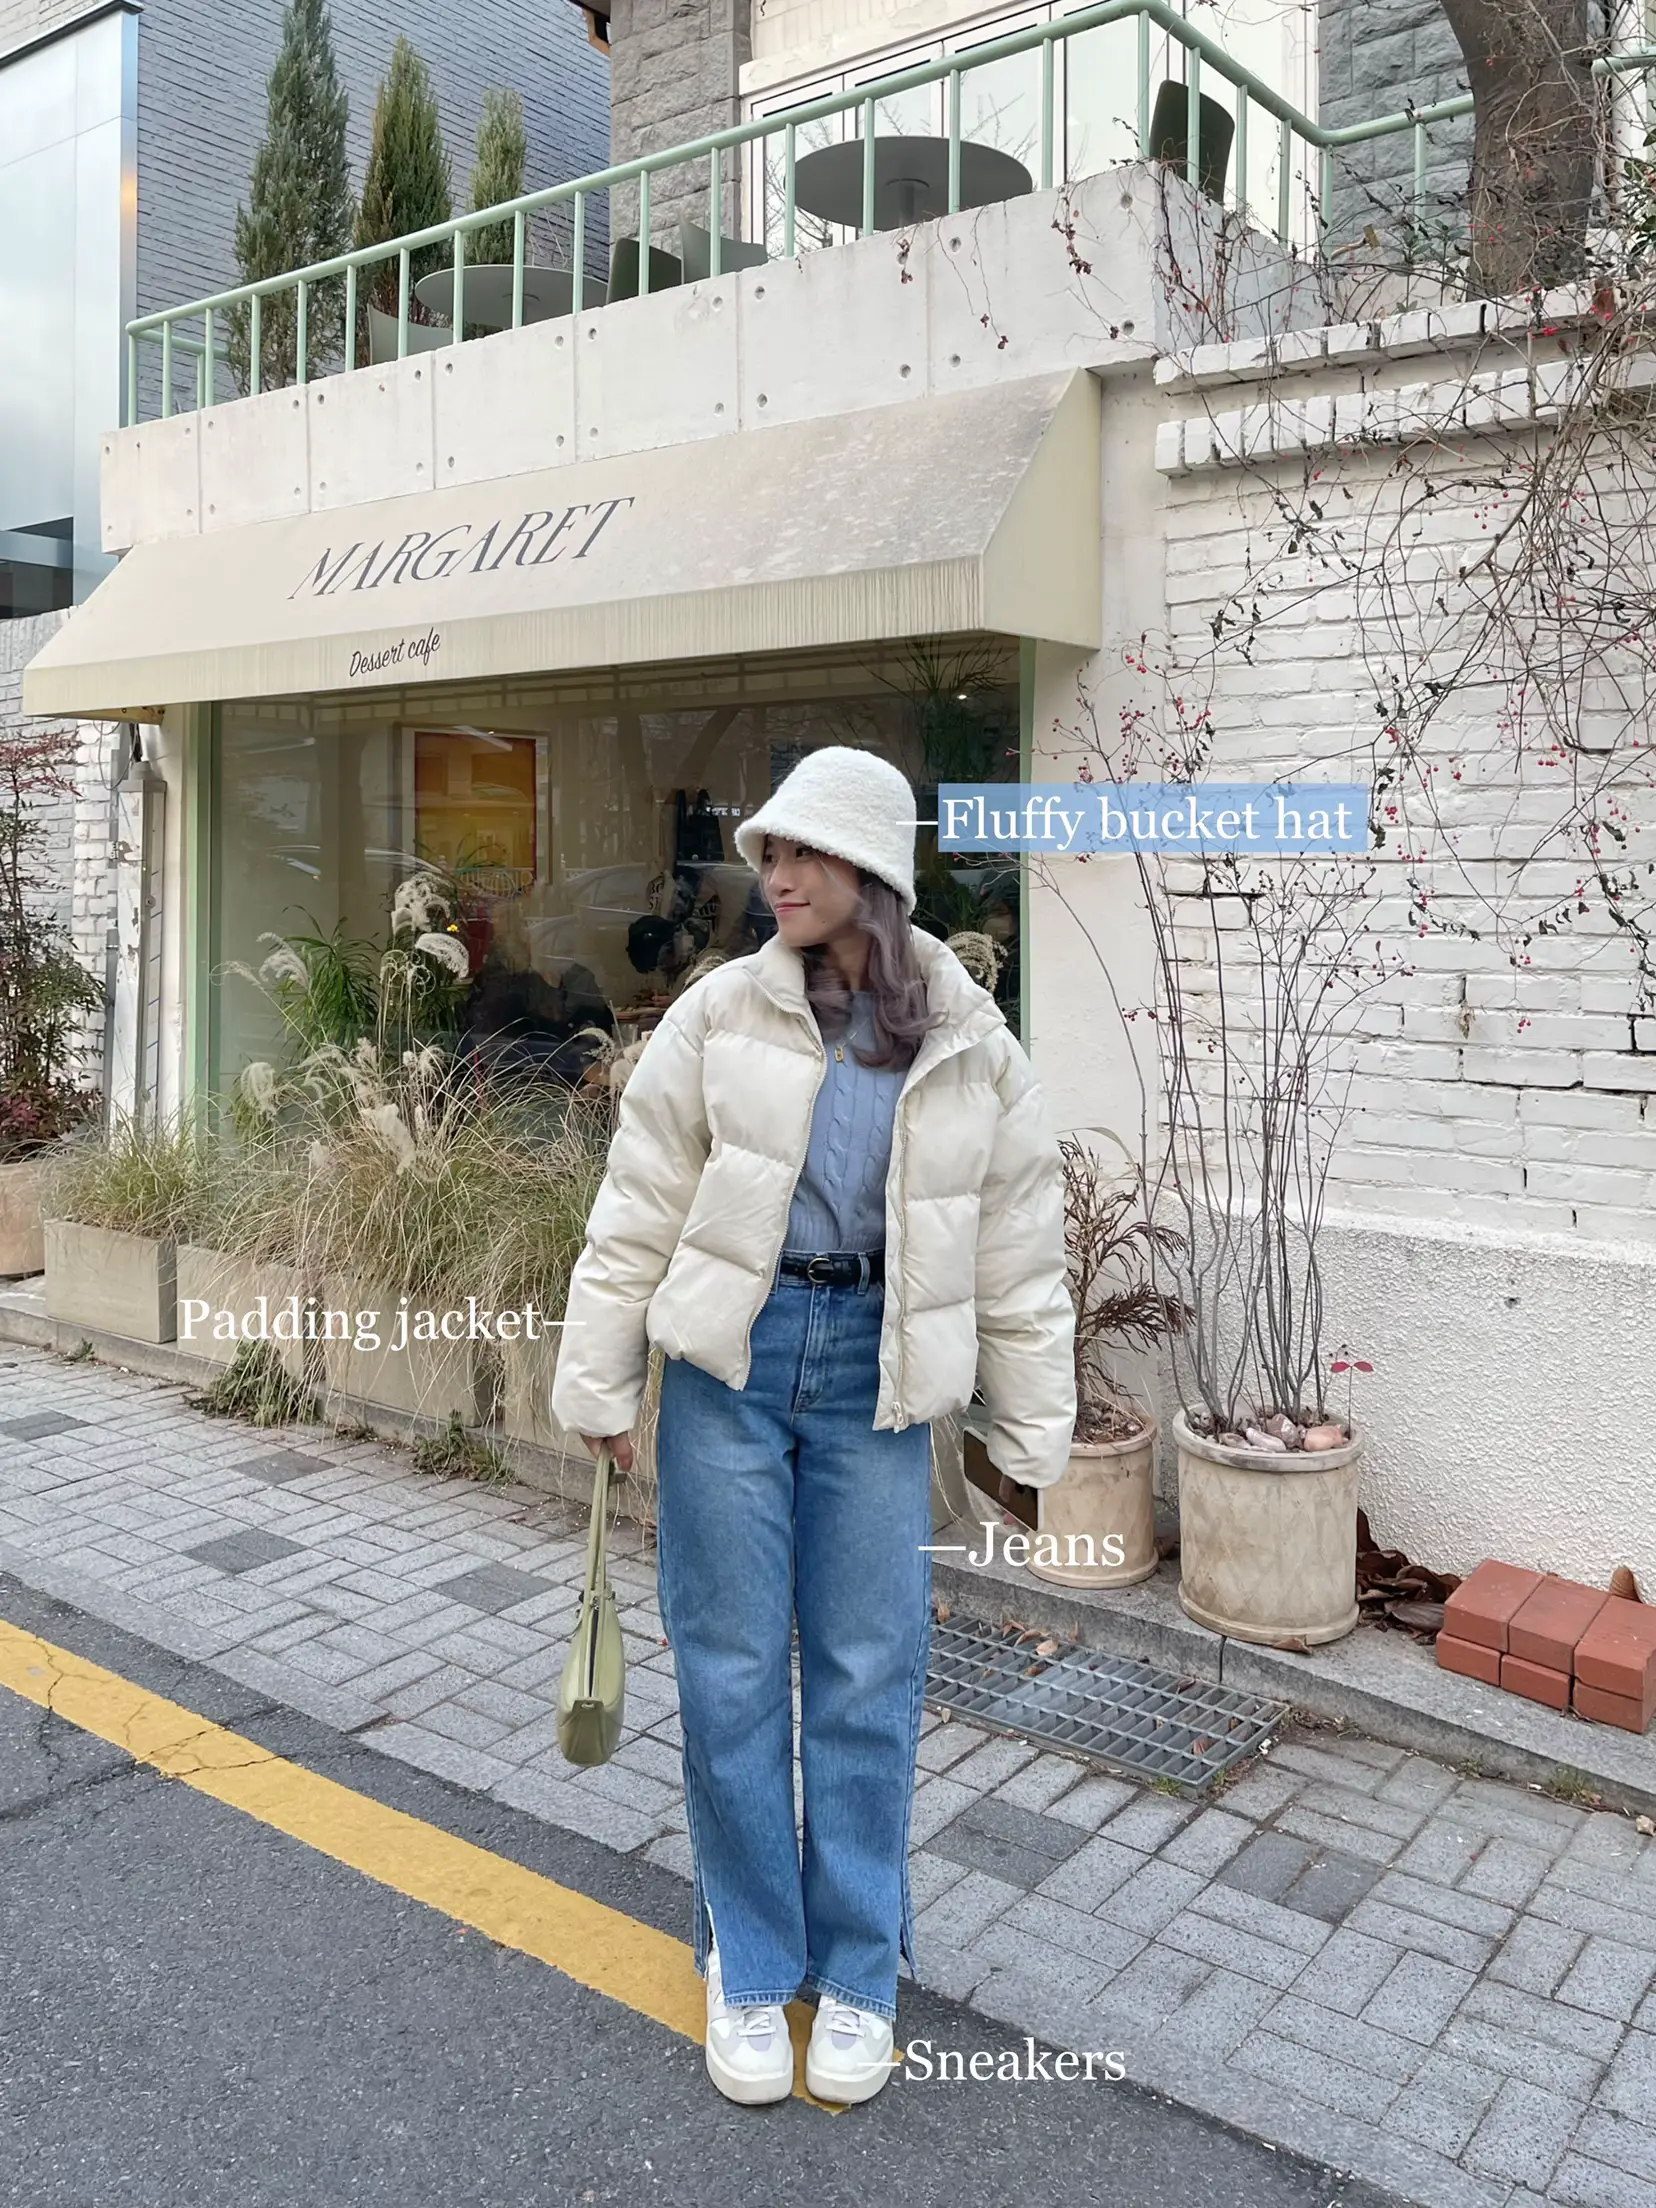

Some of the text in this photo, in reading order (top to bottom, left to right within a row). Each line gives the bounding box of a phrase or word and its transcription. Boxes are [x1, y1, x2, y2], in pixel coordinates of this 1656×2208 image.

[286, 496, 636, 600] MARGARET
[349, 626, 441, 677] Dessert cafe
